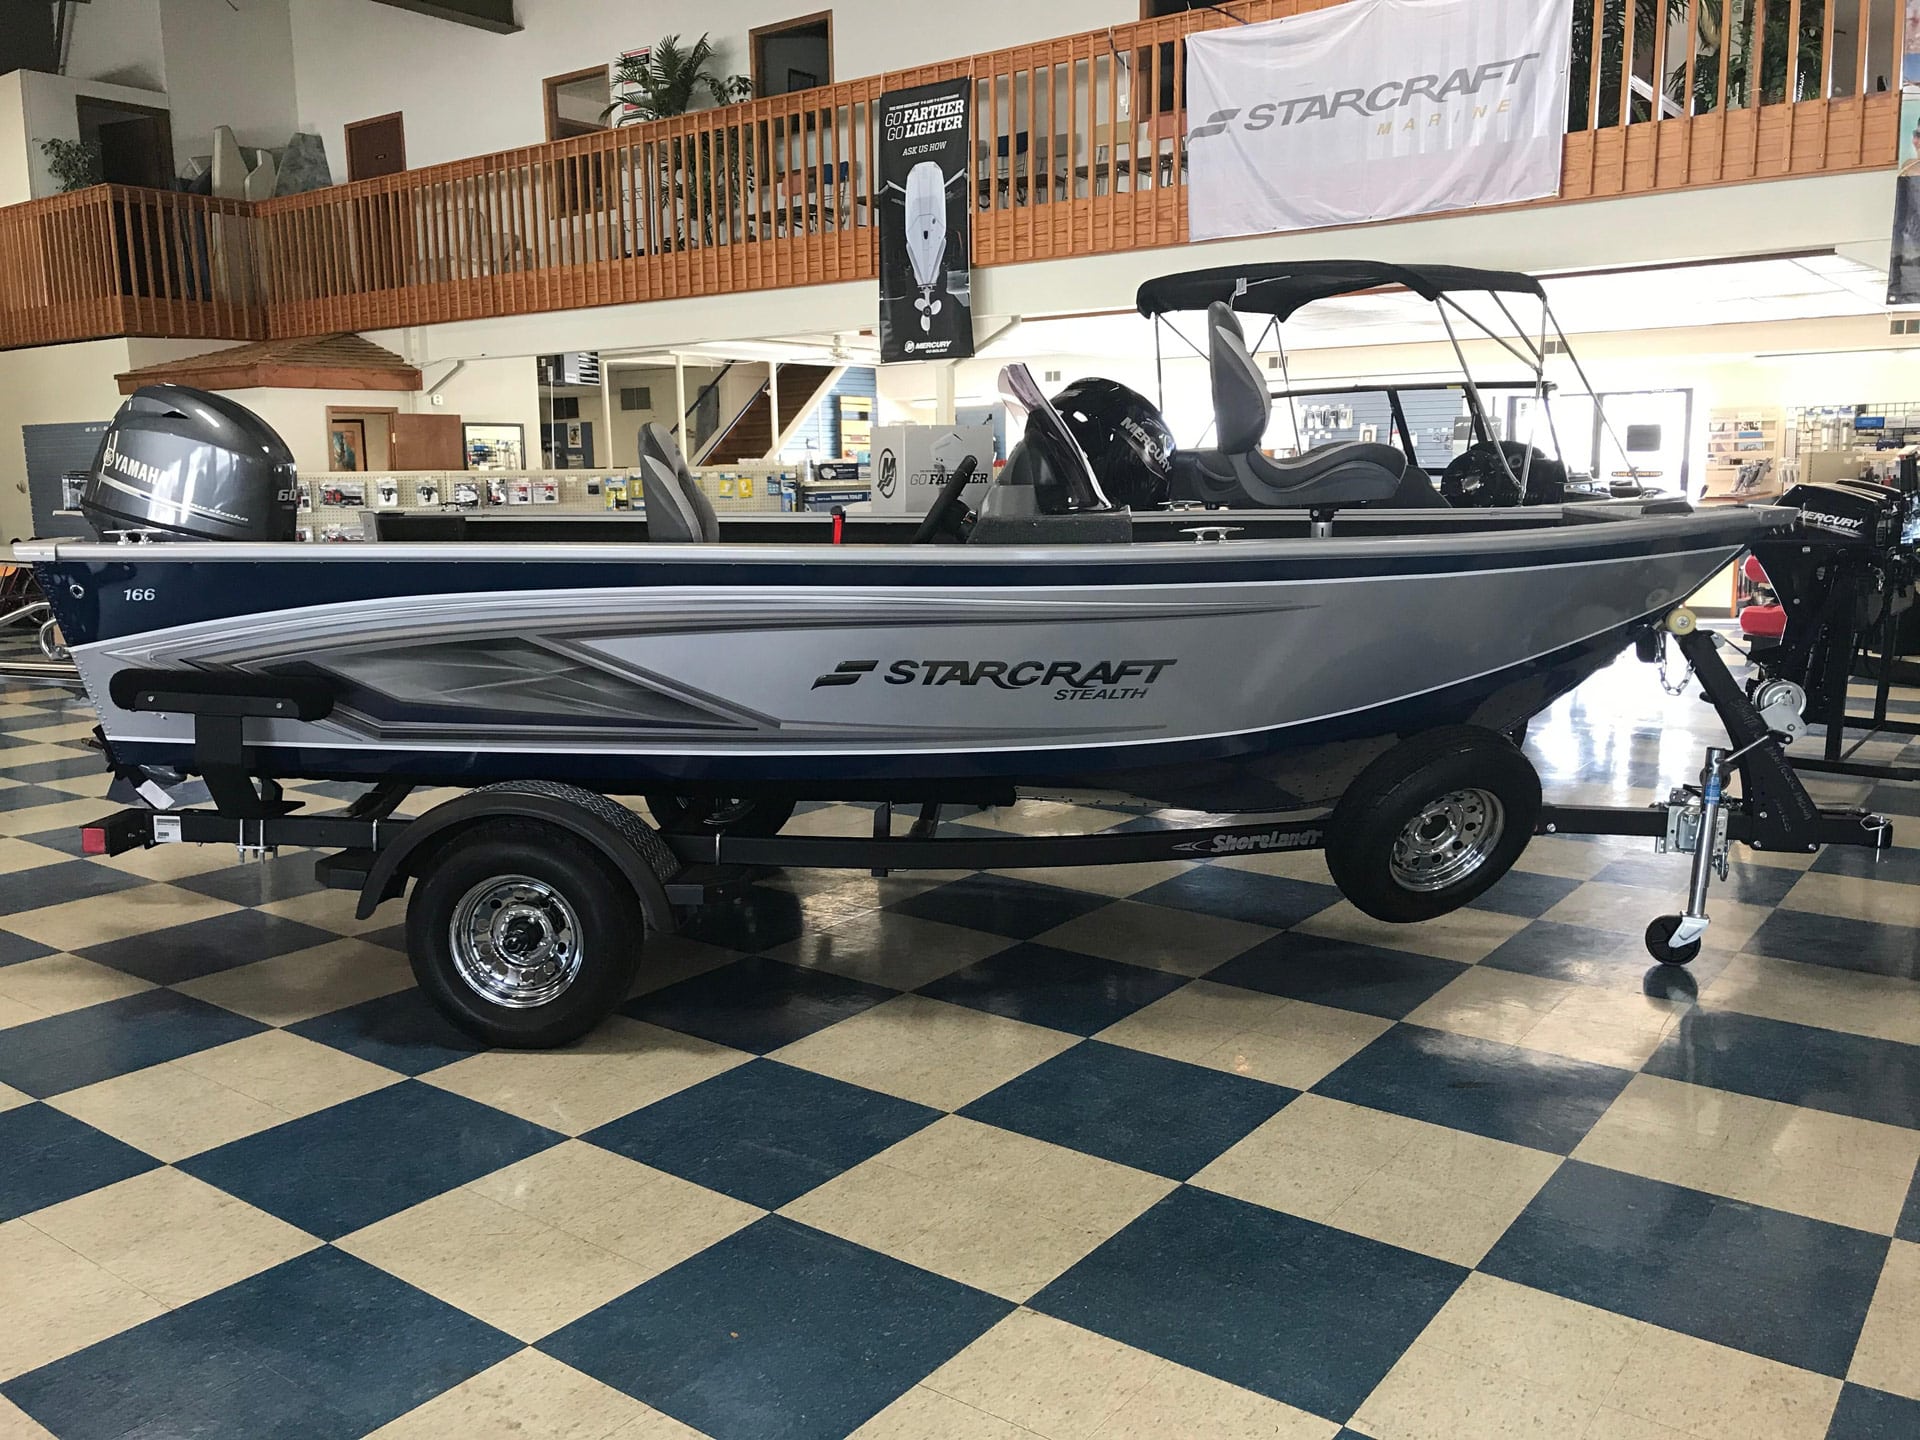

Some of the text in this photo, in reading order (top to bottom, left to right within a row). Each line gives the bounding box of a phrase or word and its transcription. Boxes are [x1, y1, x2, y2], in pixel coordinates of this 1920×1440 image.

[1244, 53, 1540, 131] STARCRAFT
[885, 112, 902, 127] GO
[903, 99, 965, 124] FARTHER
[1376, 99, 1511, 136] MARINE
[887, 115, 963, 141] GO LIGHTER
[902, 140, 947, 157] ASK US HOW
[915, 340, 952, 350] MERCURY
[1120, 416, 1173, 473] MERCURY
[910, 473, 988, 486] GO FARER
[278, 489, 297, 501] 60
[1797, 509, 1864, 529] MERCURY
[123, 588, 156, 601] 166
[883, 658, 1178, 690] STARCRAFT
[1053, 687, 1149, 701] STEALTH
